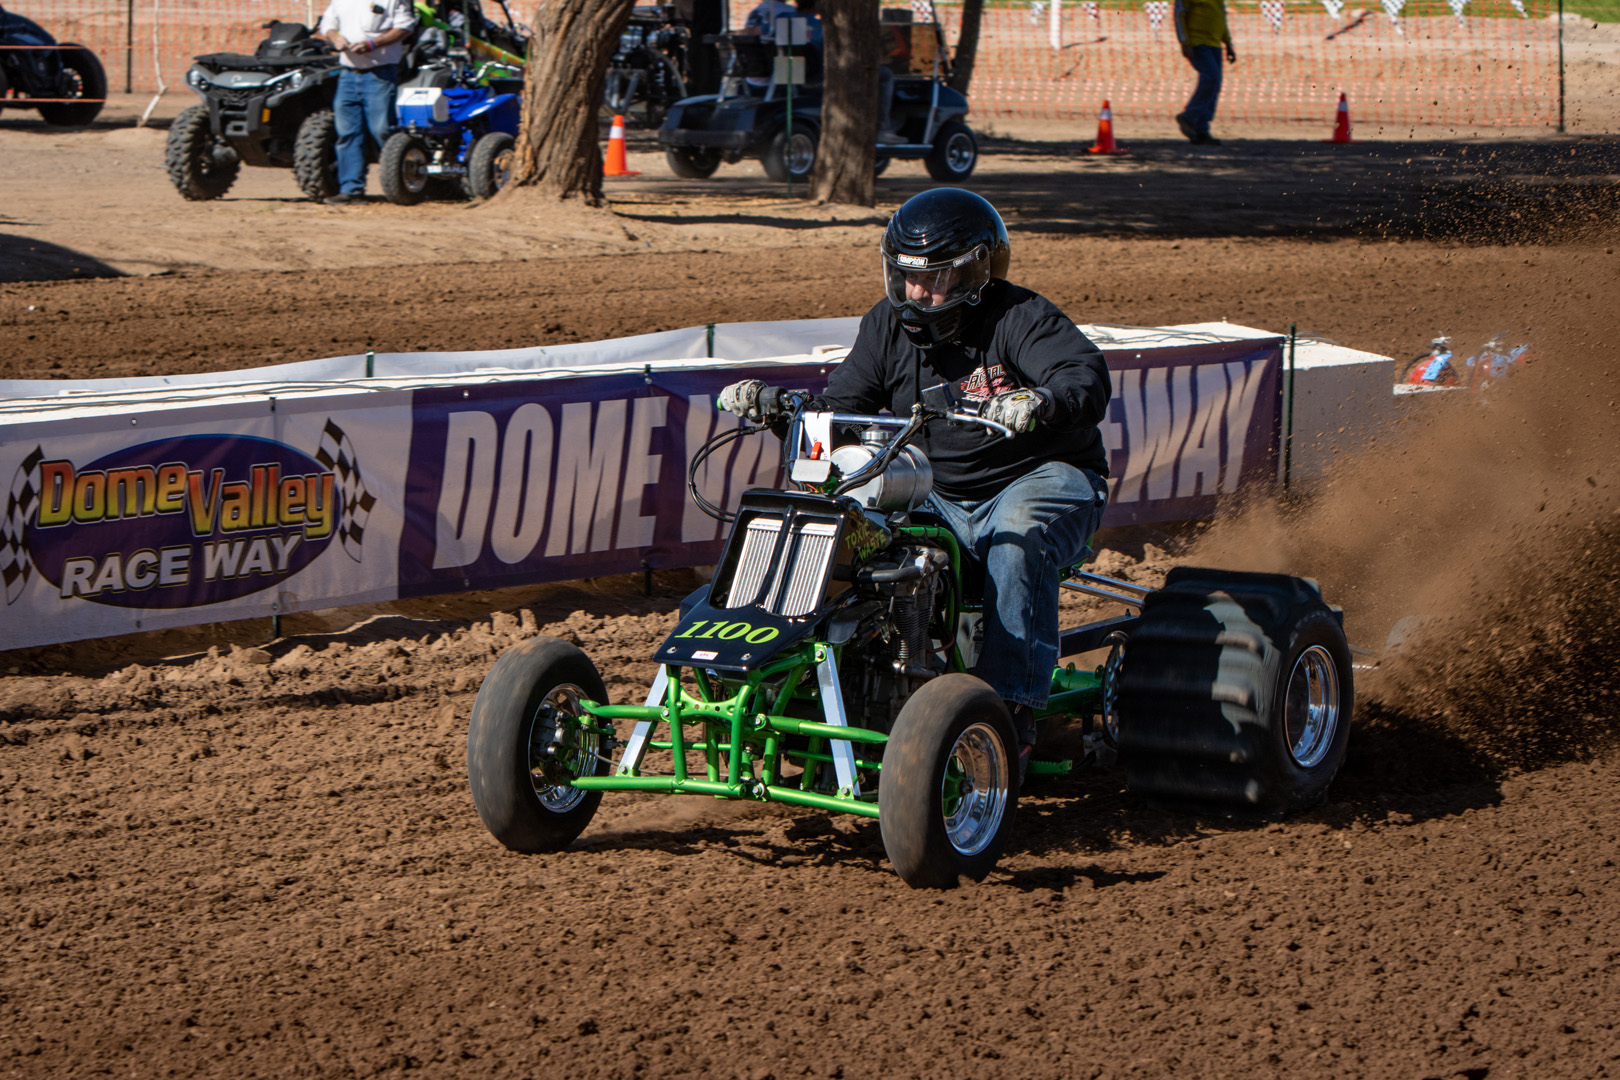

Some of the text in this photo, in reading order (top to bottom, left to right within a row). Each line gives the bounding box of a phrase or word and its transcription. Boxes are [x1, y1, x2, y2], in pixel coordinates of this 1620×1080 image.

[898, 254, 927, 268] SIMPSON
[36, 459, 336, 541] Dome Valley
[432, 396, 670, 570] DOME
[60, 531, 303, 600] RACE WAY
[859, 528, 887, 561] WASTE
[674, 620, 780, 644] 1100
